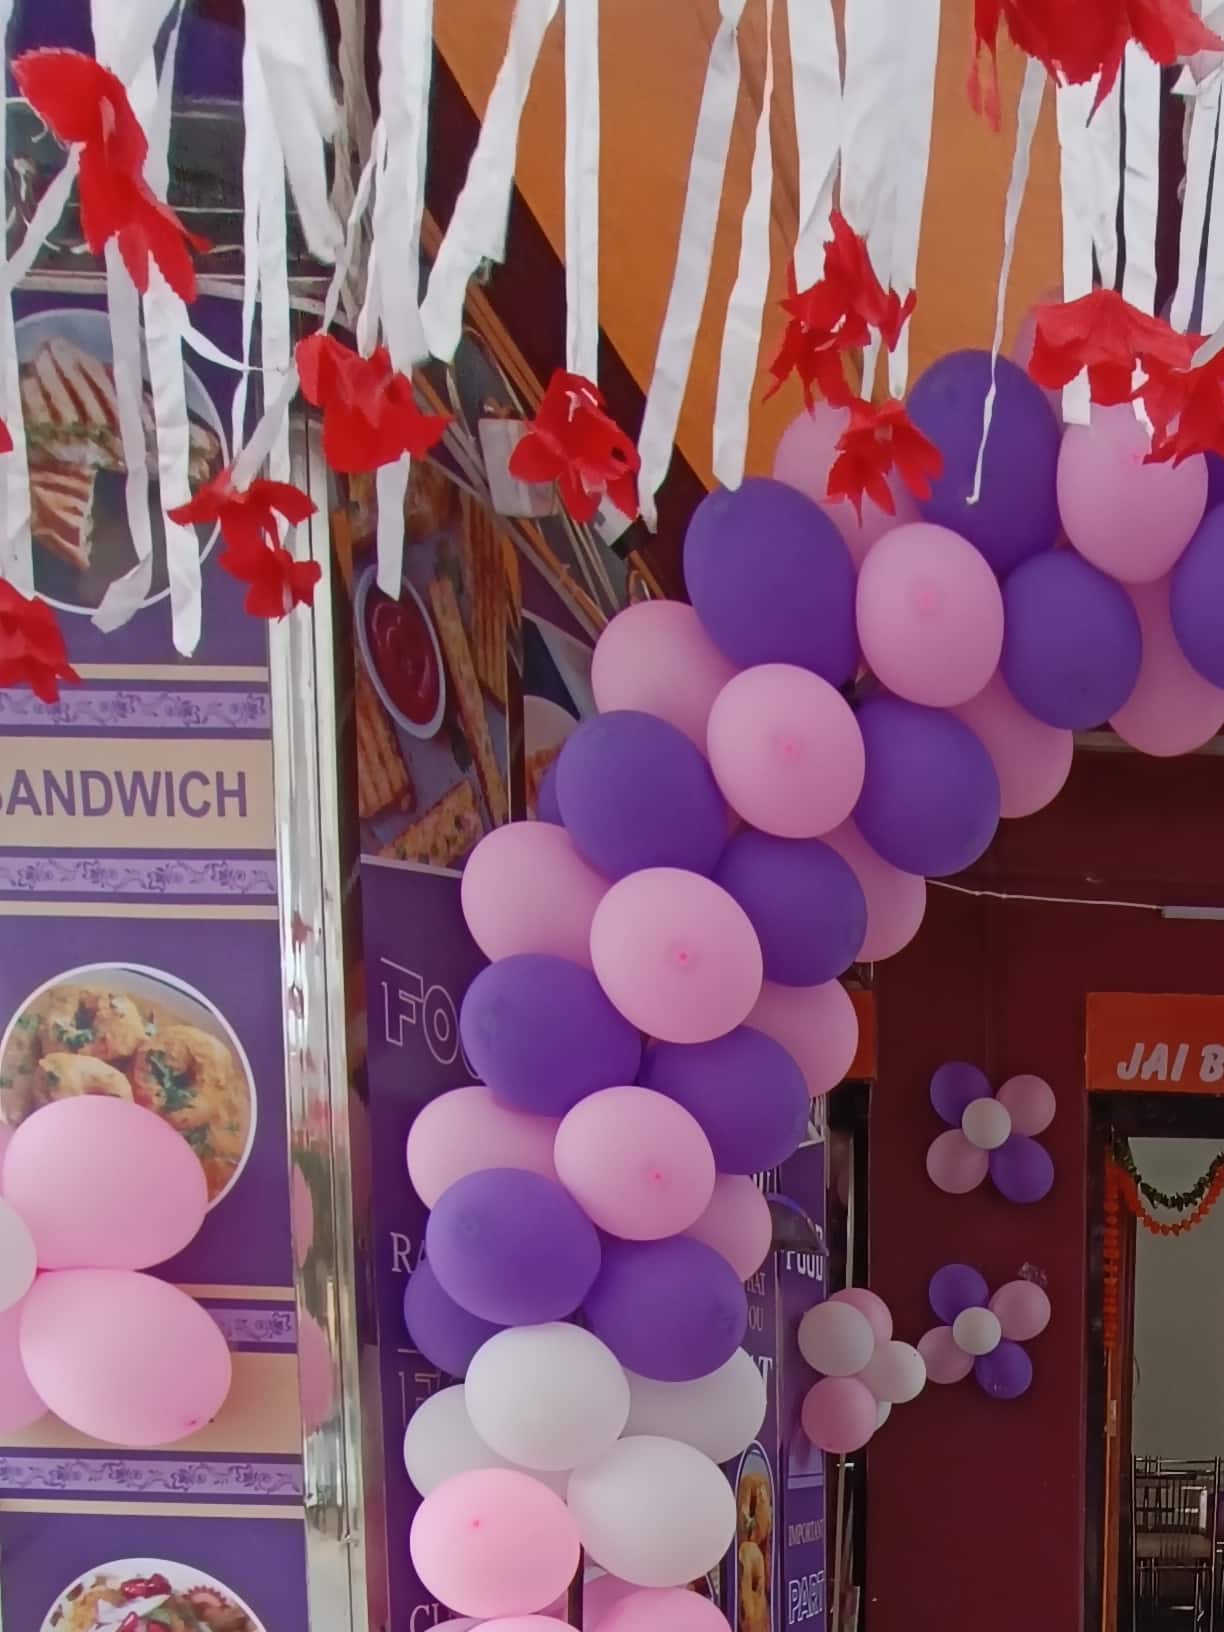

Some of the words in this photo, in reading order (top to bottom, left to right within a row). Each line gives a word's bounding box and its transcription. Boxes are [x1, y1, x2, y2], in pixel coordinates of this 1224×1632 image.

[0, 768, 248, 818] ANDWICH
[1116, 1042, 1190, 1082] JAI
[788, 1570, 824, 1625] PART
